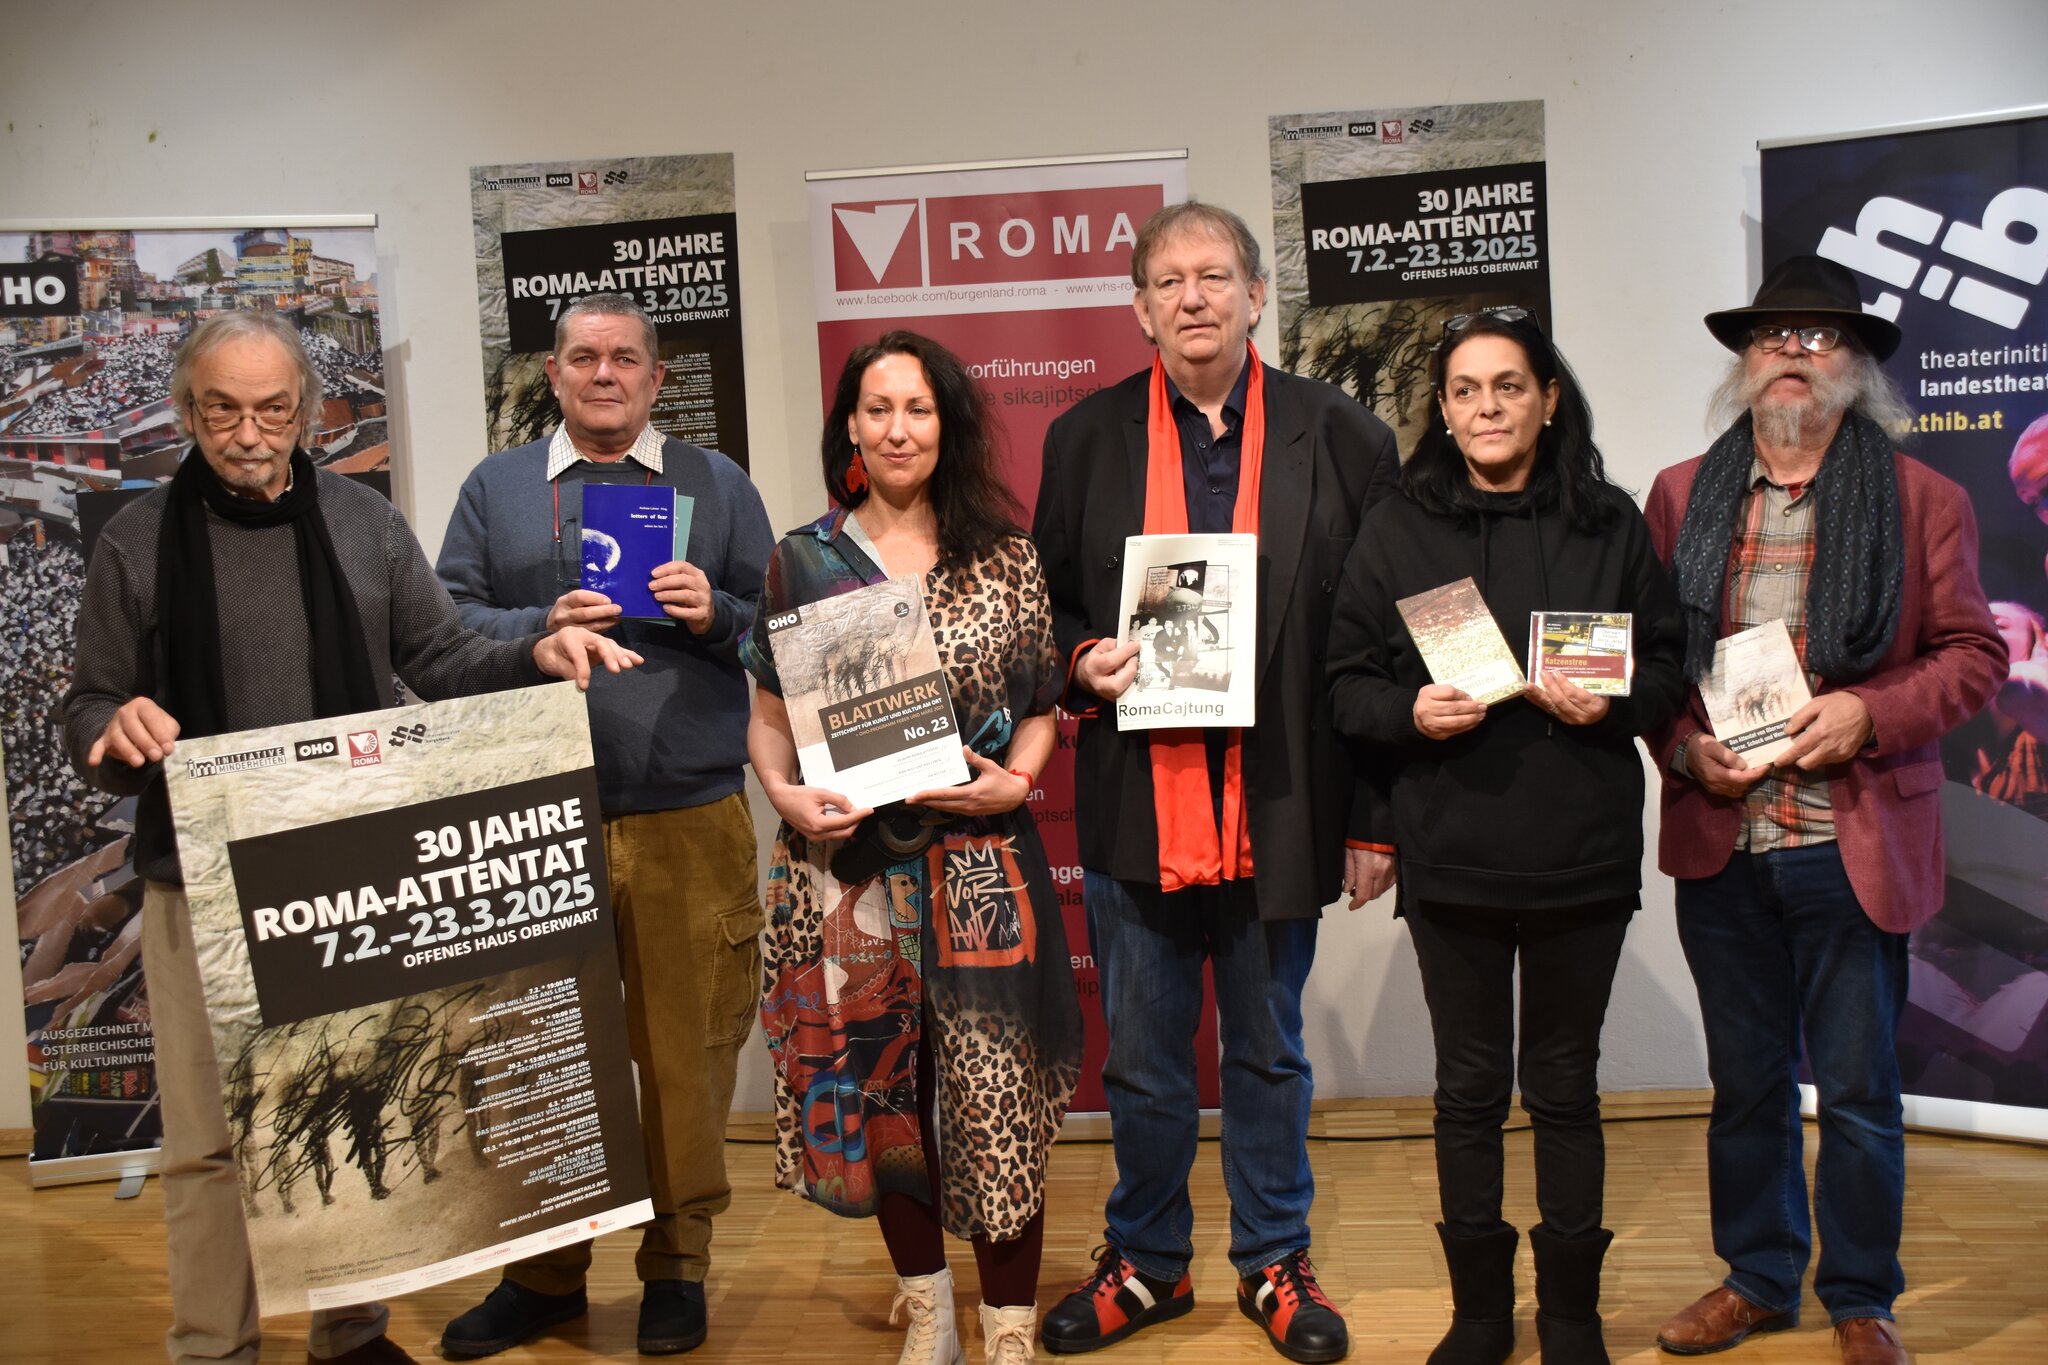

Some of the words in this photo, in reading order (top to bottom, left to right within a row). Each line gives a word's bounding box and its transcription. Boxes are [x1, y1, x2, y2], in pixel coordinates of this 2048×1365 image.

[1351, 125, 1373, 134] OHO
[549, 176, 570, 184] OHO
[1418, 189, 1448, 213] 30
[1452, 181, 1534, 215] JAHRE
[950, 213, 1137, 261] ROMA
[1311, 209, 1535, 251] ROMA-ATTENTAT
[613, 240, 643, 262] 30
[646, 232, 724, 265] JAHRE
[512, 259, 726, 299] ROMA-ATTENTAT
[1401, 268, 1447, 281] OFFENES
[1450, 265, 1479, 278] HAUS
[1481, 260, 1539, 274] OBERWART
[0, 276, 66, 305] HO
[837, 286, 1046, 306] www.facebook.com/burgenland.roma
[1066, 281, 1135, 295] www.vhs-ro
[650, 313, 672, 324] AUS
[674, 308, 730, 322] OBERWART
[1920, 343, 2047, 369] theateriniti
[768, 613, 798, 630] OHO
[1545, 657, 1587, 666] Katzenstreu
[828, 680, 940, 730] BLATTWERK
[1118, 702, 1224, 717] RomaCajtung
[831, 725, 861, 738] ZEITSCHRIFT
[861, 721, 872, 729] FÜR
[872, 716, 889, 725] KUNST
[902, 704, 922, 716] KULTUR
[904, 726, 930, 741] No.
[931, 716, 949, 733] 23
[216, 747, 284, 765] INITIATIVE
[299, 741, 334, 757] OHO
[218, 756, 285, 773] MINDERHEITEN
[353, 756, 380, 767] ROMA
[415, 825, 462, 863] 30
[469, 798, 585, 860] JAHRE
[253, 837, 588, 942] ROMA-ATTENTAT
[403, 940, 472, 968] OFFENES
[475, 929, 517, 952] HAUS
[520, 907, 600, 940] OBERWART
[547, 981, 562, 989] 19:00
[494, 1008, 511, 1016] GEGEN
[513, 997, 551, 1011] MINDERHEITEN
[507, 998, 523, 1006] WILL
[546, 1013, 581, 1027] FILMABEND
[41, 1023, 139, 1041] AUSGEZEICHNET
[458, 1056, 478, 1065] STEFAN
[479, 1048, 505, 1058] HORVATH
[552, 1026, 579, 1037] OBERWART
[43, 1059, 67, 1071] FÜR
[529, 1054, 545, 1063] 13:00
[561, 1064, 576, 1072] 19:00
[474, 1070, 512, 1086] WORKSHOP
[536, 1076, 559, 1086] STEFAN
[560, 1066, 590, 1079] HORVATH
[475, 1128, 489, 1136] DAS
[490, 1111, 544, 1132] ROMA-ATTENTAT
[545, 1106, 560, 1114] VON
[561, 1095, 595, 1110] OBERWART
[540, 1113, 598, 1135] THEATER-PREMIERE
[577, 1119, 599, 1129] RETTER
[522, 1170, 556, 1185] OBERWART
[591, 1154, 604, 1162] UND
[537, 1164, 556, 1174] JAHRE
[557, 1153, 588, 1167] ATTENTAT
[547, 1171, 574, 1183] STINATZ
